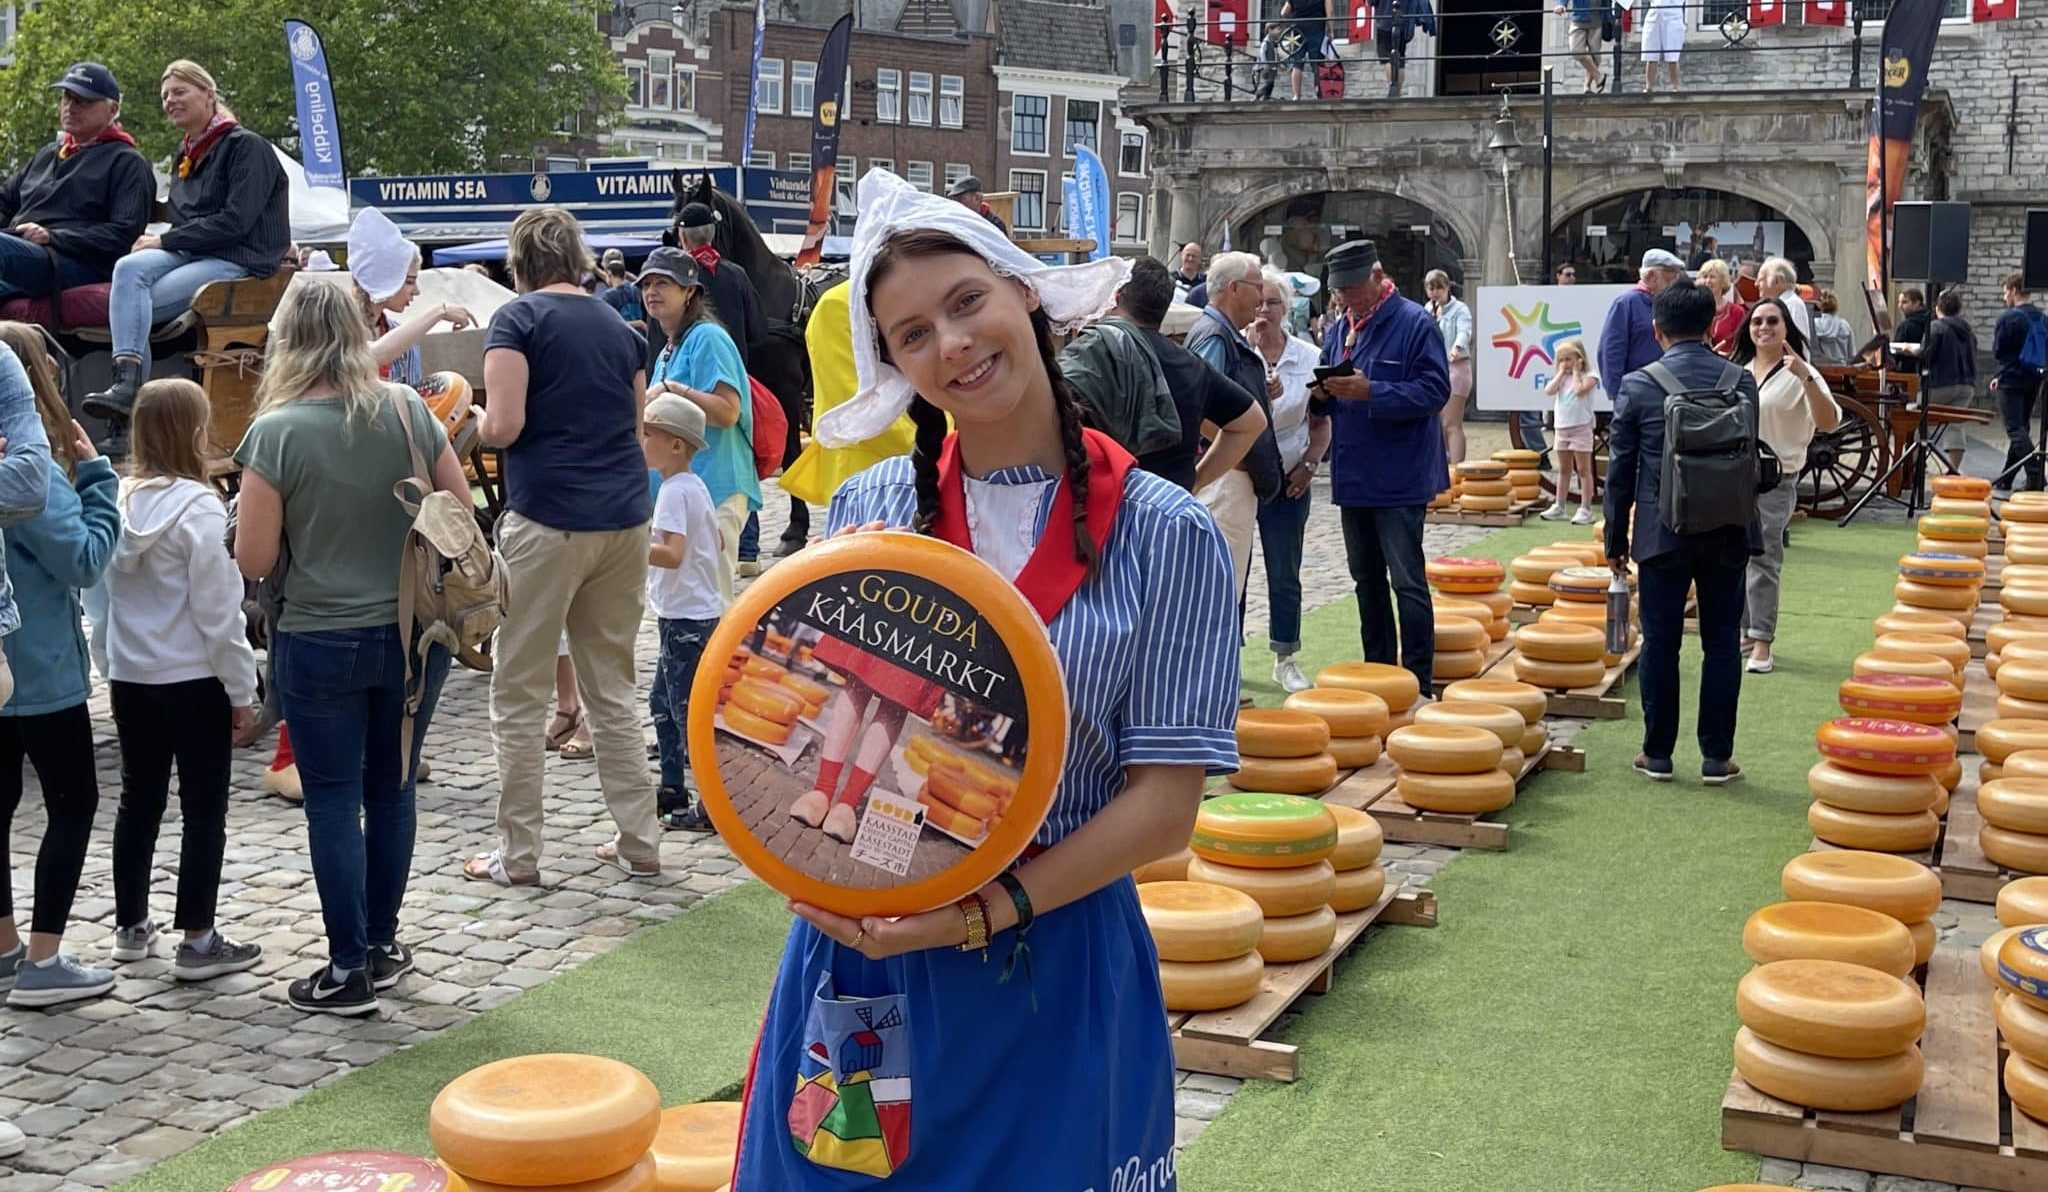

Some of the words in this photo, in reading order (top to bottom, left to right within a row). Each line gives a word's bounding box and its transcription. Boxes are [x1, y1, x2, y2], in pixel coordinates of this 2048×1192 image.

[379, 181, 451, 201] VITAMIN
[454, 180, 488, 199] SEA
[596, 173, 676, 196] VITAMIN
[859, 574, 978, 649] GOUDA
[806, 591, 1006, 699] KAASMARKT
[865, 816, 918, 842] KAASSTAD
